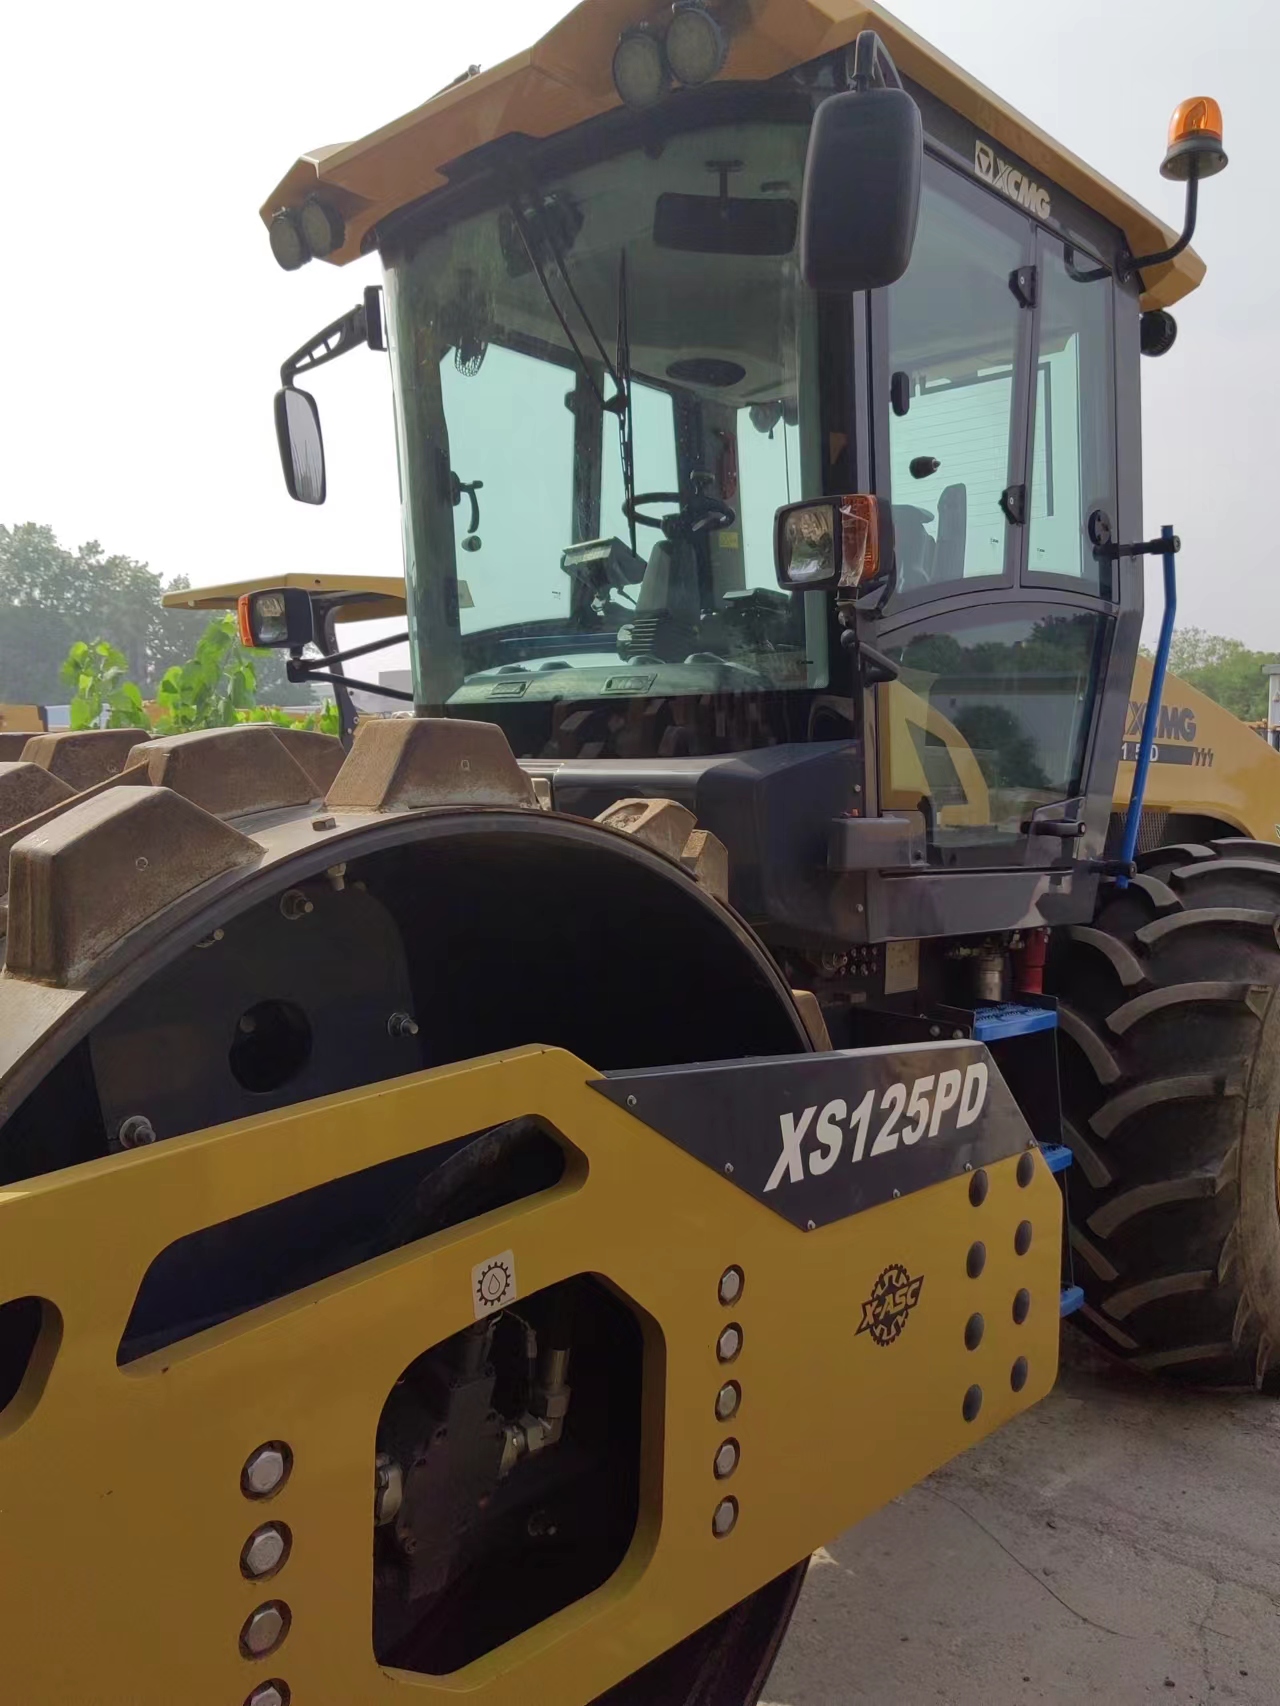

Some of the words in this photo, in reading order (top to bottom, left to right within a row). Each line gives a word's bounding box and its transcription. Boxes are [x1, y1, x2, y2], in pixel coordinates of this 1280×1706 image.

[992, 157, 1051, 220] XCMG
[1125, 701, 1197, 742] XMG
[763, 1062, 989, 1192] XS125PD
[861, 1280, 920, 1329] X-ASC
